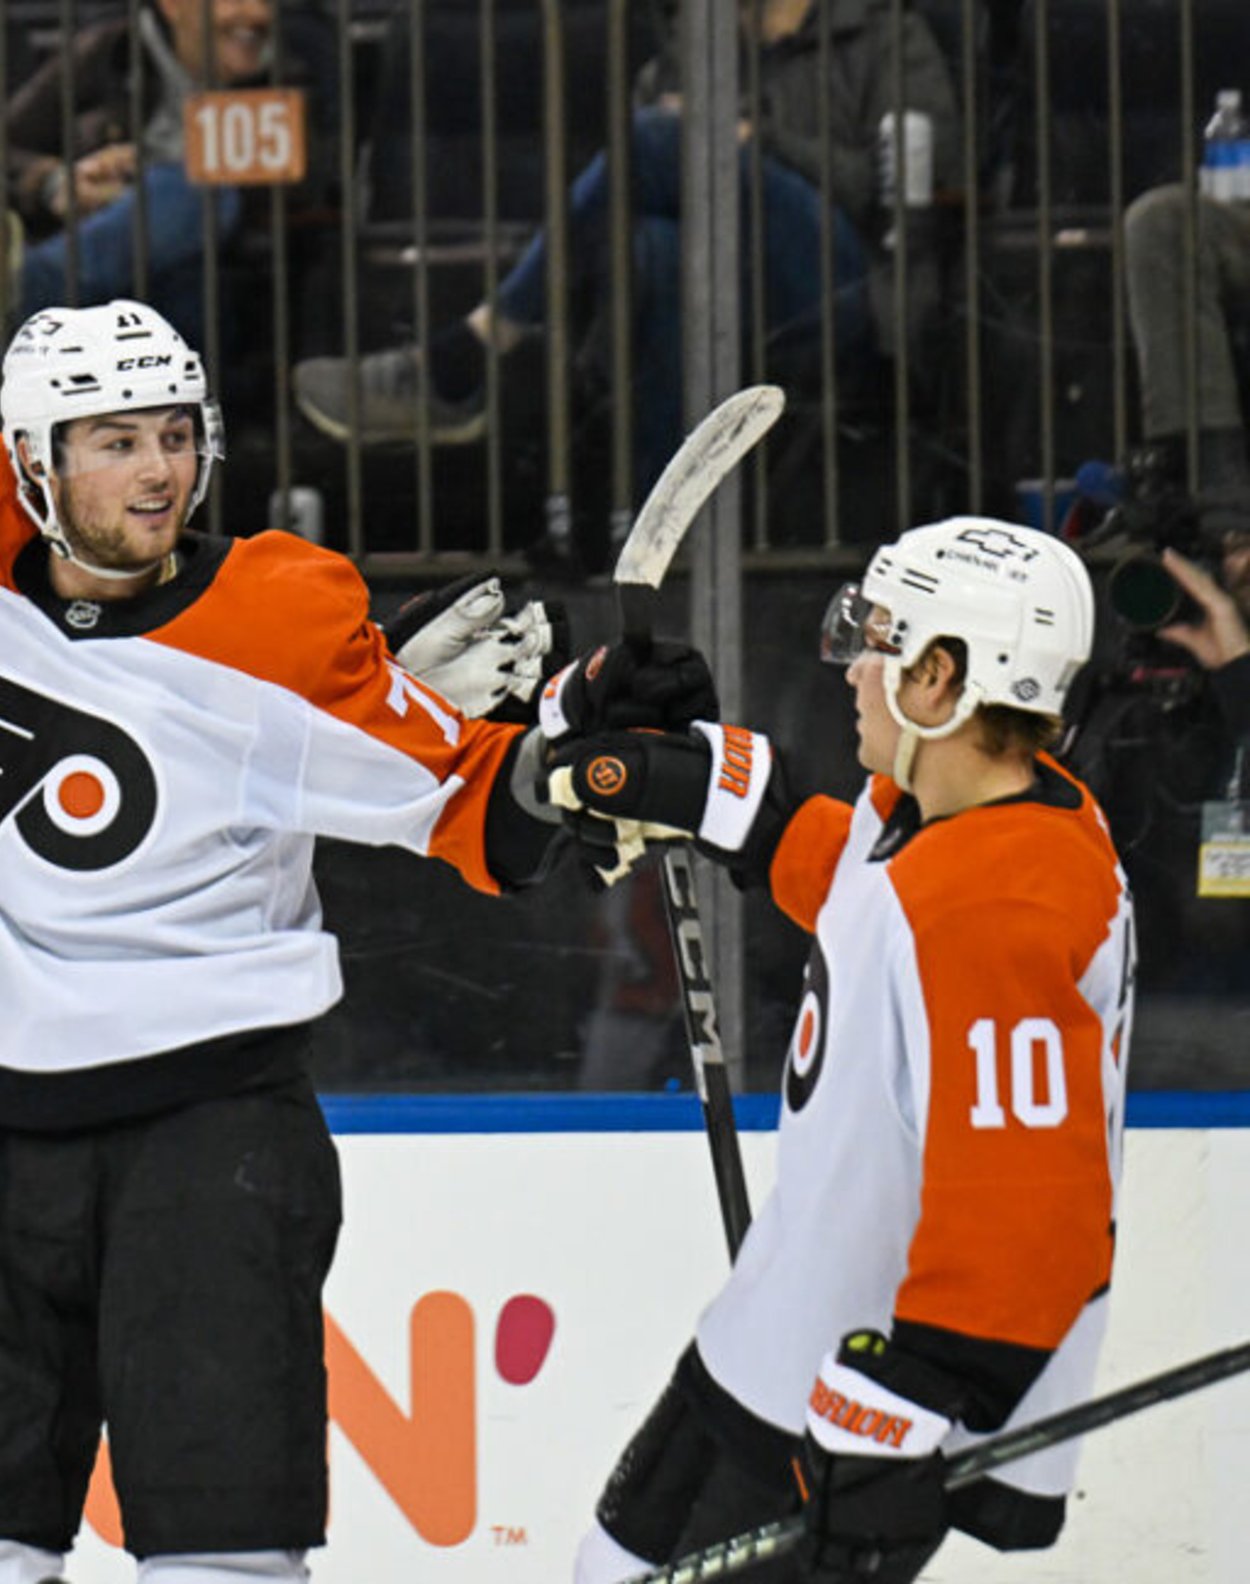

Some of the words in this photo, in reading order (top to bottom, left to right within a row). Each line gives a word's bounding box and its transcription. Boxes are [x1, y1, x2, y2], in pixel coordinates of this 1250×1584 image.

[196, 102, 291, 173] 105
[116, 354, 172, 372] CCM
[664, 846, 724, 1066] CCM
[967, 1017, 1069, 1130] 10
[490, 1525, 528, 1547] TM
